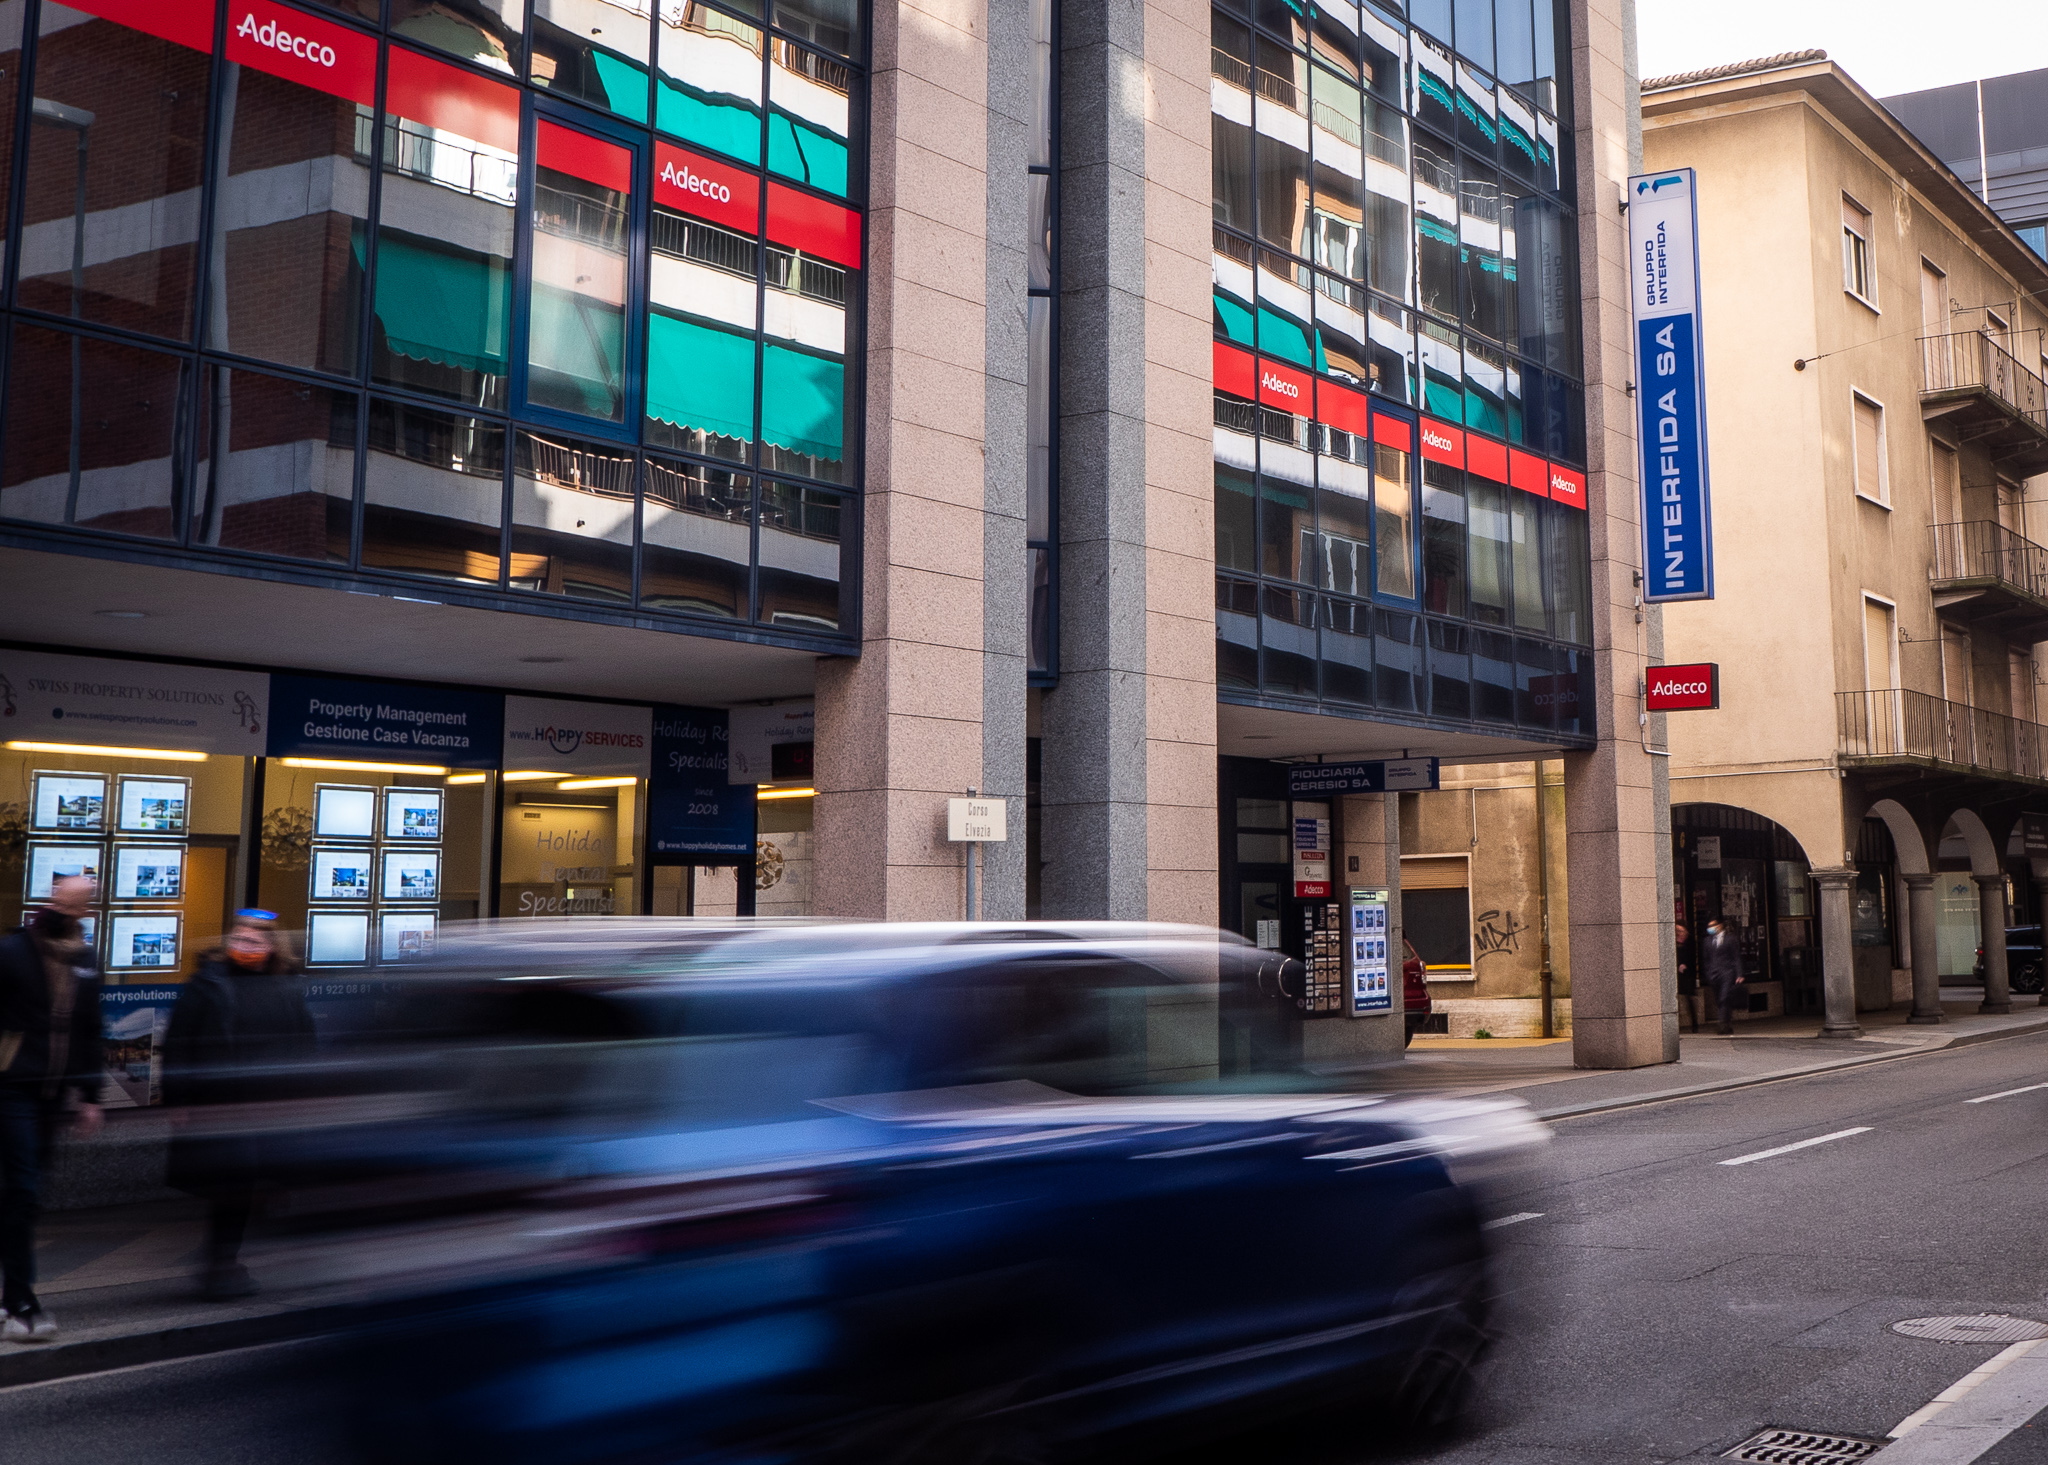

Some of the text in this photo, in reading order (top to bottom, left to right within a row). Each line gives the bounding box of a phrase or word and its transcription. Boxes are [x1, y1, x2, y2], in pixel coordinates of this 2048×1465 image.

[236, 13, 336, 67] Adecco
[660, 161, 730, 203] Adecco
[1657, 220, 1668, 304] INTERFIDA
[1645, 240, 1656, 306] GRUPPO
[1262, 372, 1298, 398] Adecco
[1422, 429, 1452, 452] Adecco
[1656, 322, 1684, 589] INTERFIDA SA
[1552, 474, 1576, 494] Adecco
[27, 678, 225, 706] SWISS PROPERTY SOLUTIONS
[1651, 680, 1707, 696] Adecco
[65, 710, 198, 727] www.swisspropertysolutions.com
[309, 698, 467, 726] Property Management
[303, 721, 470, 748] Gestione Case Vacanza
[653, 721, 706, 745] Holiday
[668, 751, 728, 772] Specialis
[1291, 767, 1365, 779] FIDUCIARIA
[694, 787, 714, 797] since
[1291, 778, 1371, 791] CERESIO SA
[687, 803, 719, 815] 2008
[968, 802, 988, 816] Corso
[965, 823, 991, 837] Elvezia
[666, 840, 747, 853] www.happyholidayhomes.net
[540, 861, 608, 882] Rental
[1304, 884, 1324, 895] Adecco
[99, 989, 182, 1003] pertysolutions.
[326, 984, 344, 995] 922
[346, 984, 358, 994] 08
